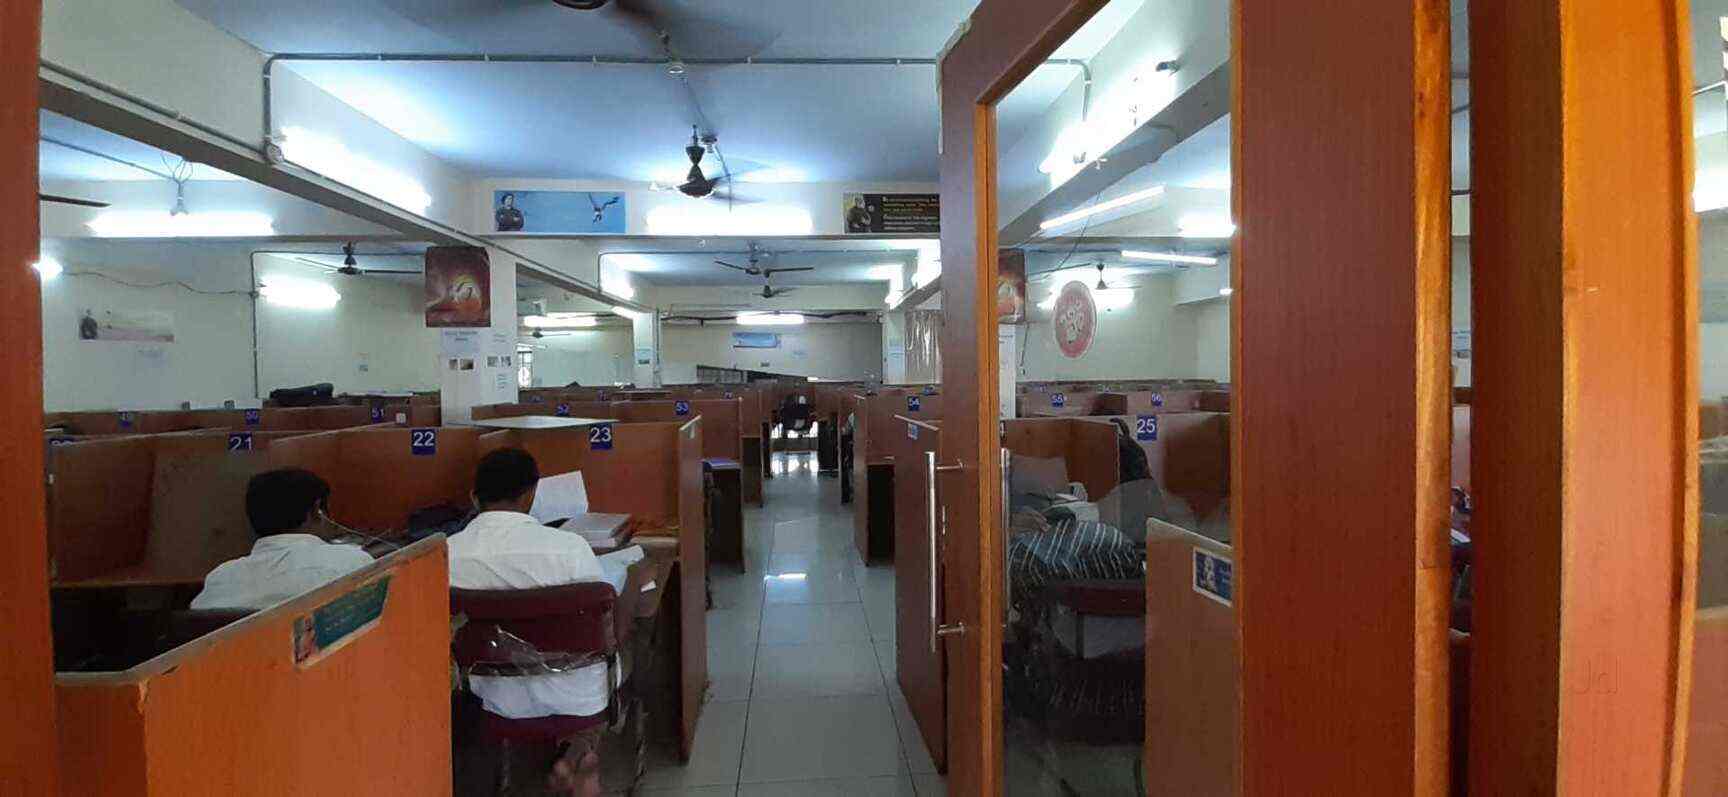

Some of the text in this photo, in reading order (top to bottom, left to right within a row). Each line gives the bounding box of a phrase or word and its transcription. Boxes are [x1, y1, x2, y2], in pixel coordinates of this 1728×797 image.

[1136, 418, 1156, 433] 25
[413, 431, 435, 447] 22
[590, 427, 612, 443] 23
[228, 436, 253, 452] 21
